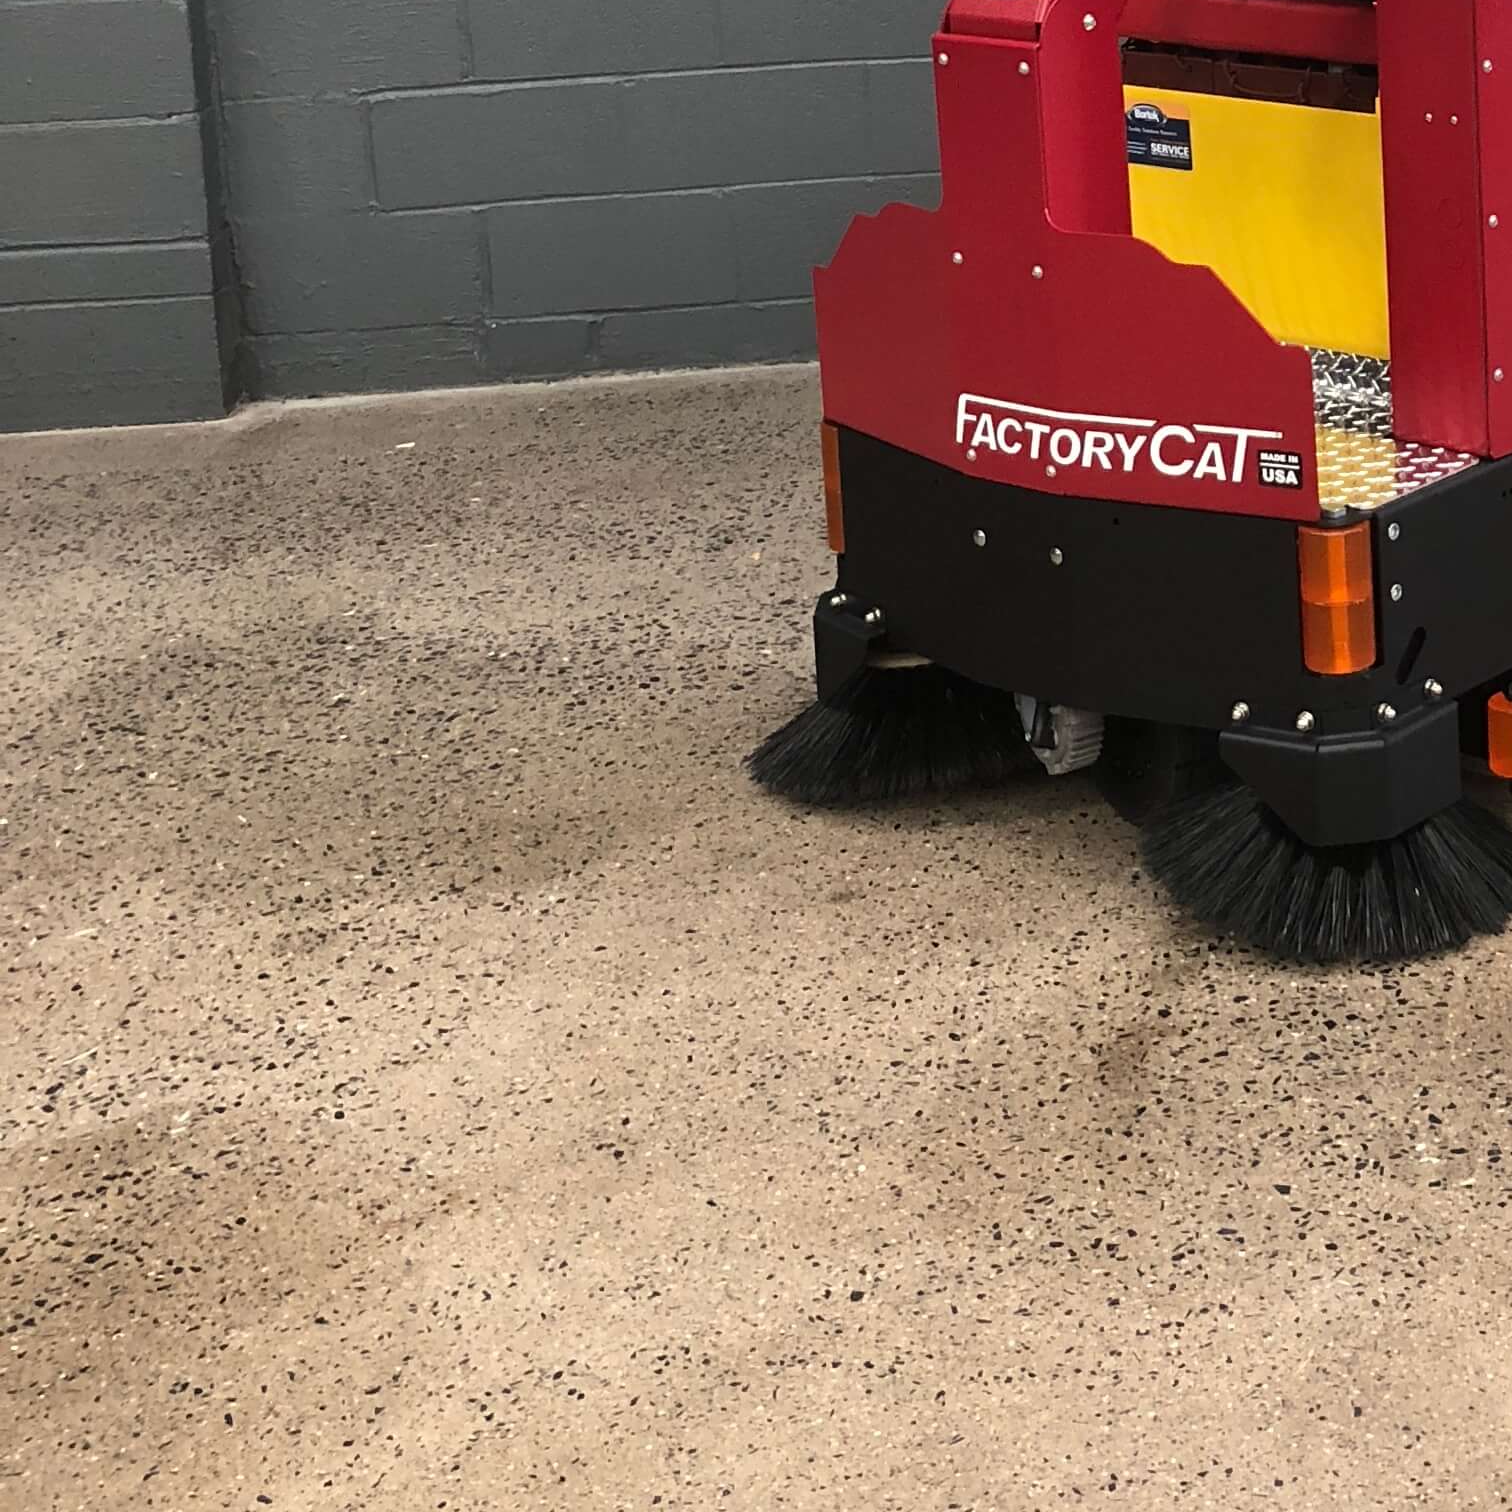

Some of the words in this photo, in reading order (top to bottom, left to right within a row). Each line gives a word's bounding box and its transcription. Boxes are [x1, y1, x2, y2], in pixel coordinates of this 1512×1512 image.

[1150, 142, 1190, 157] SERVICE
[1259, 452, 1286, 463] MADE
[1287, 454, 1299, 464] IN
[1261, 467, 1299, 485] USA
